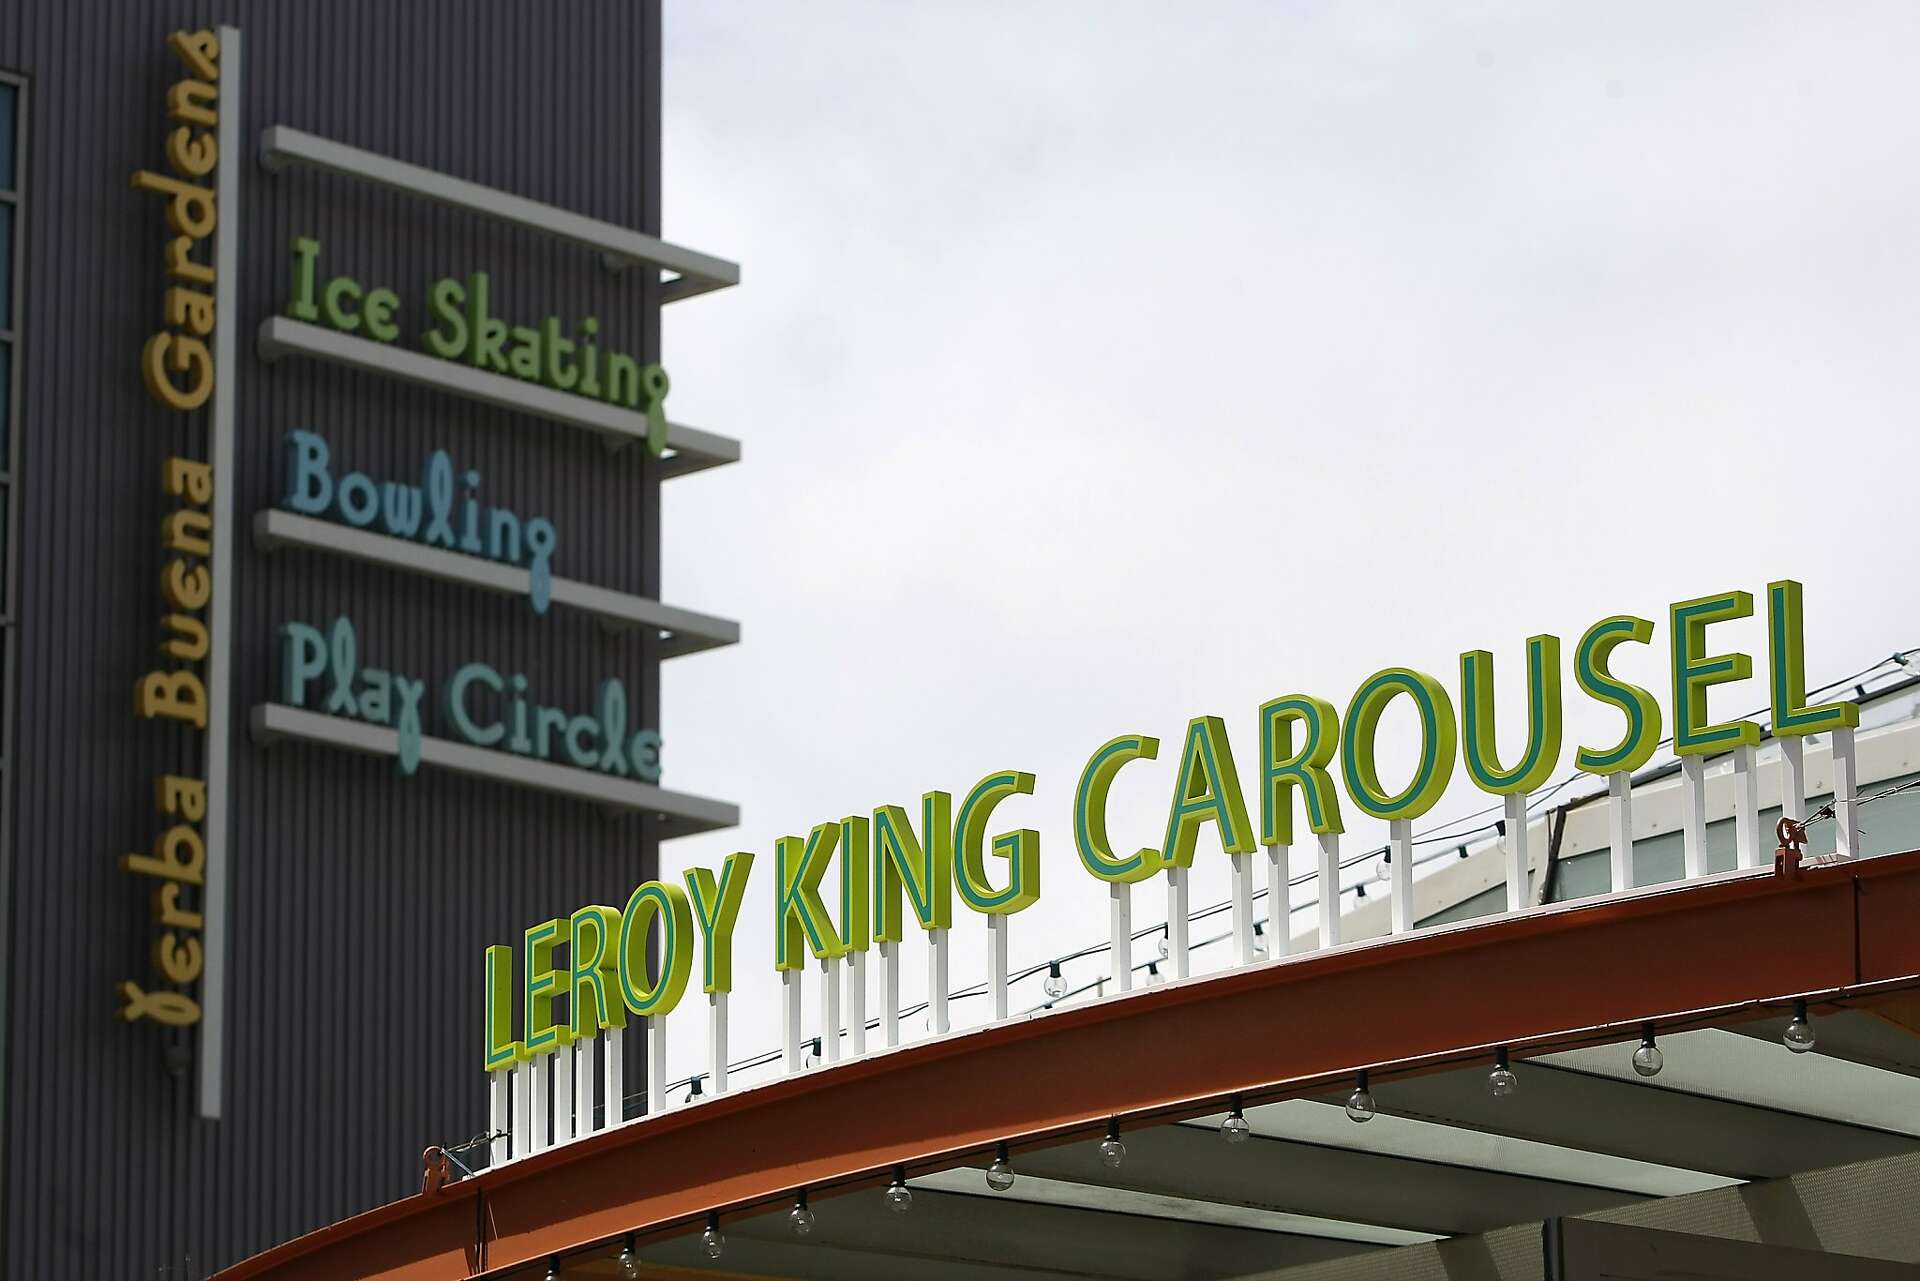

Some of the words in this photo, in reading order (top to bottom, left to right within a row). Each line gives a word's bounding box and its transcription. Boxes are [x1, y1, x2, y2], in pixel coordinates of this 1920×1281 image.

[132, 28, 220, 411] Gardens
[287, 236, 400, 341] Ice
[421, 272, 671, 457] Skating
[135, 458, 213, 728] Buena
[285, 429, 556, 614] Bowling
[282, 616, 425, 774] Play
[445, 662, 662, 780] Circle
[485, 852, 755, 1072] LEROY
[775, 769, 1040, 972] KING
[1073, 579, 1860, 884] CAROUSEL
[114, 772, 206, 1028] Yerba
